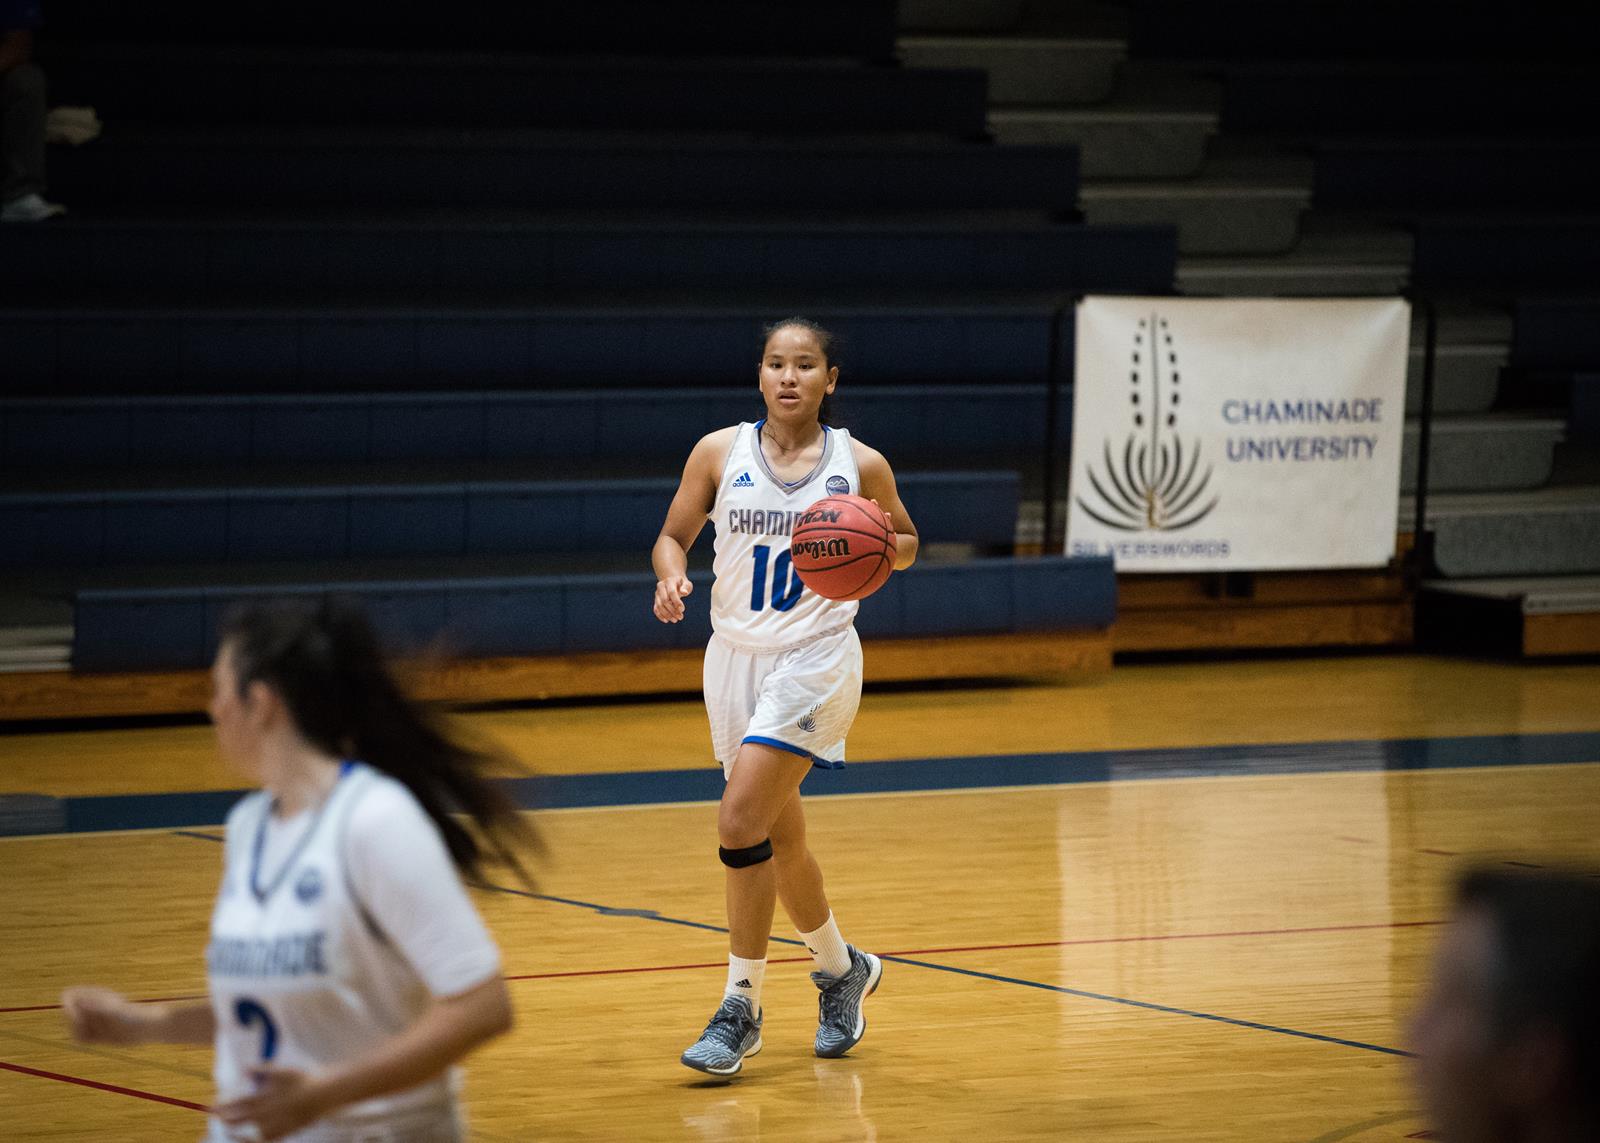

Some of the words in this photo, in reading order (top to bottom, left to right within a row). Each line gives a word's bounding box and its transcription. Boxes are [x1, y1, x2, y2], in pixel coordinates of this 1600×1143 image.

[1222, 399, 1382, 424] CHAMINADE
[1226, 435, 1378, 462] UNIVERSITY
[793, 538, 850, 560] Wilson
[751, 545, 804, 612] 10
